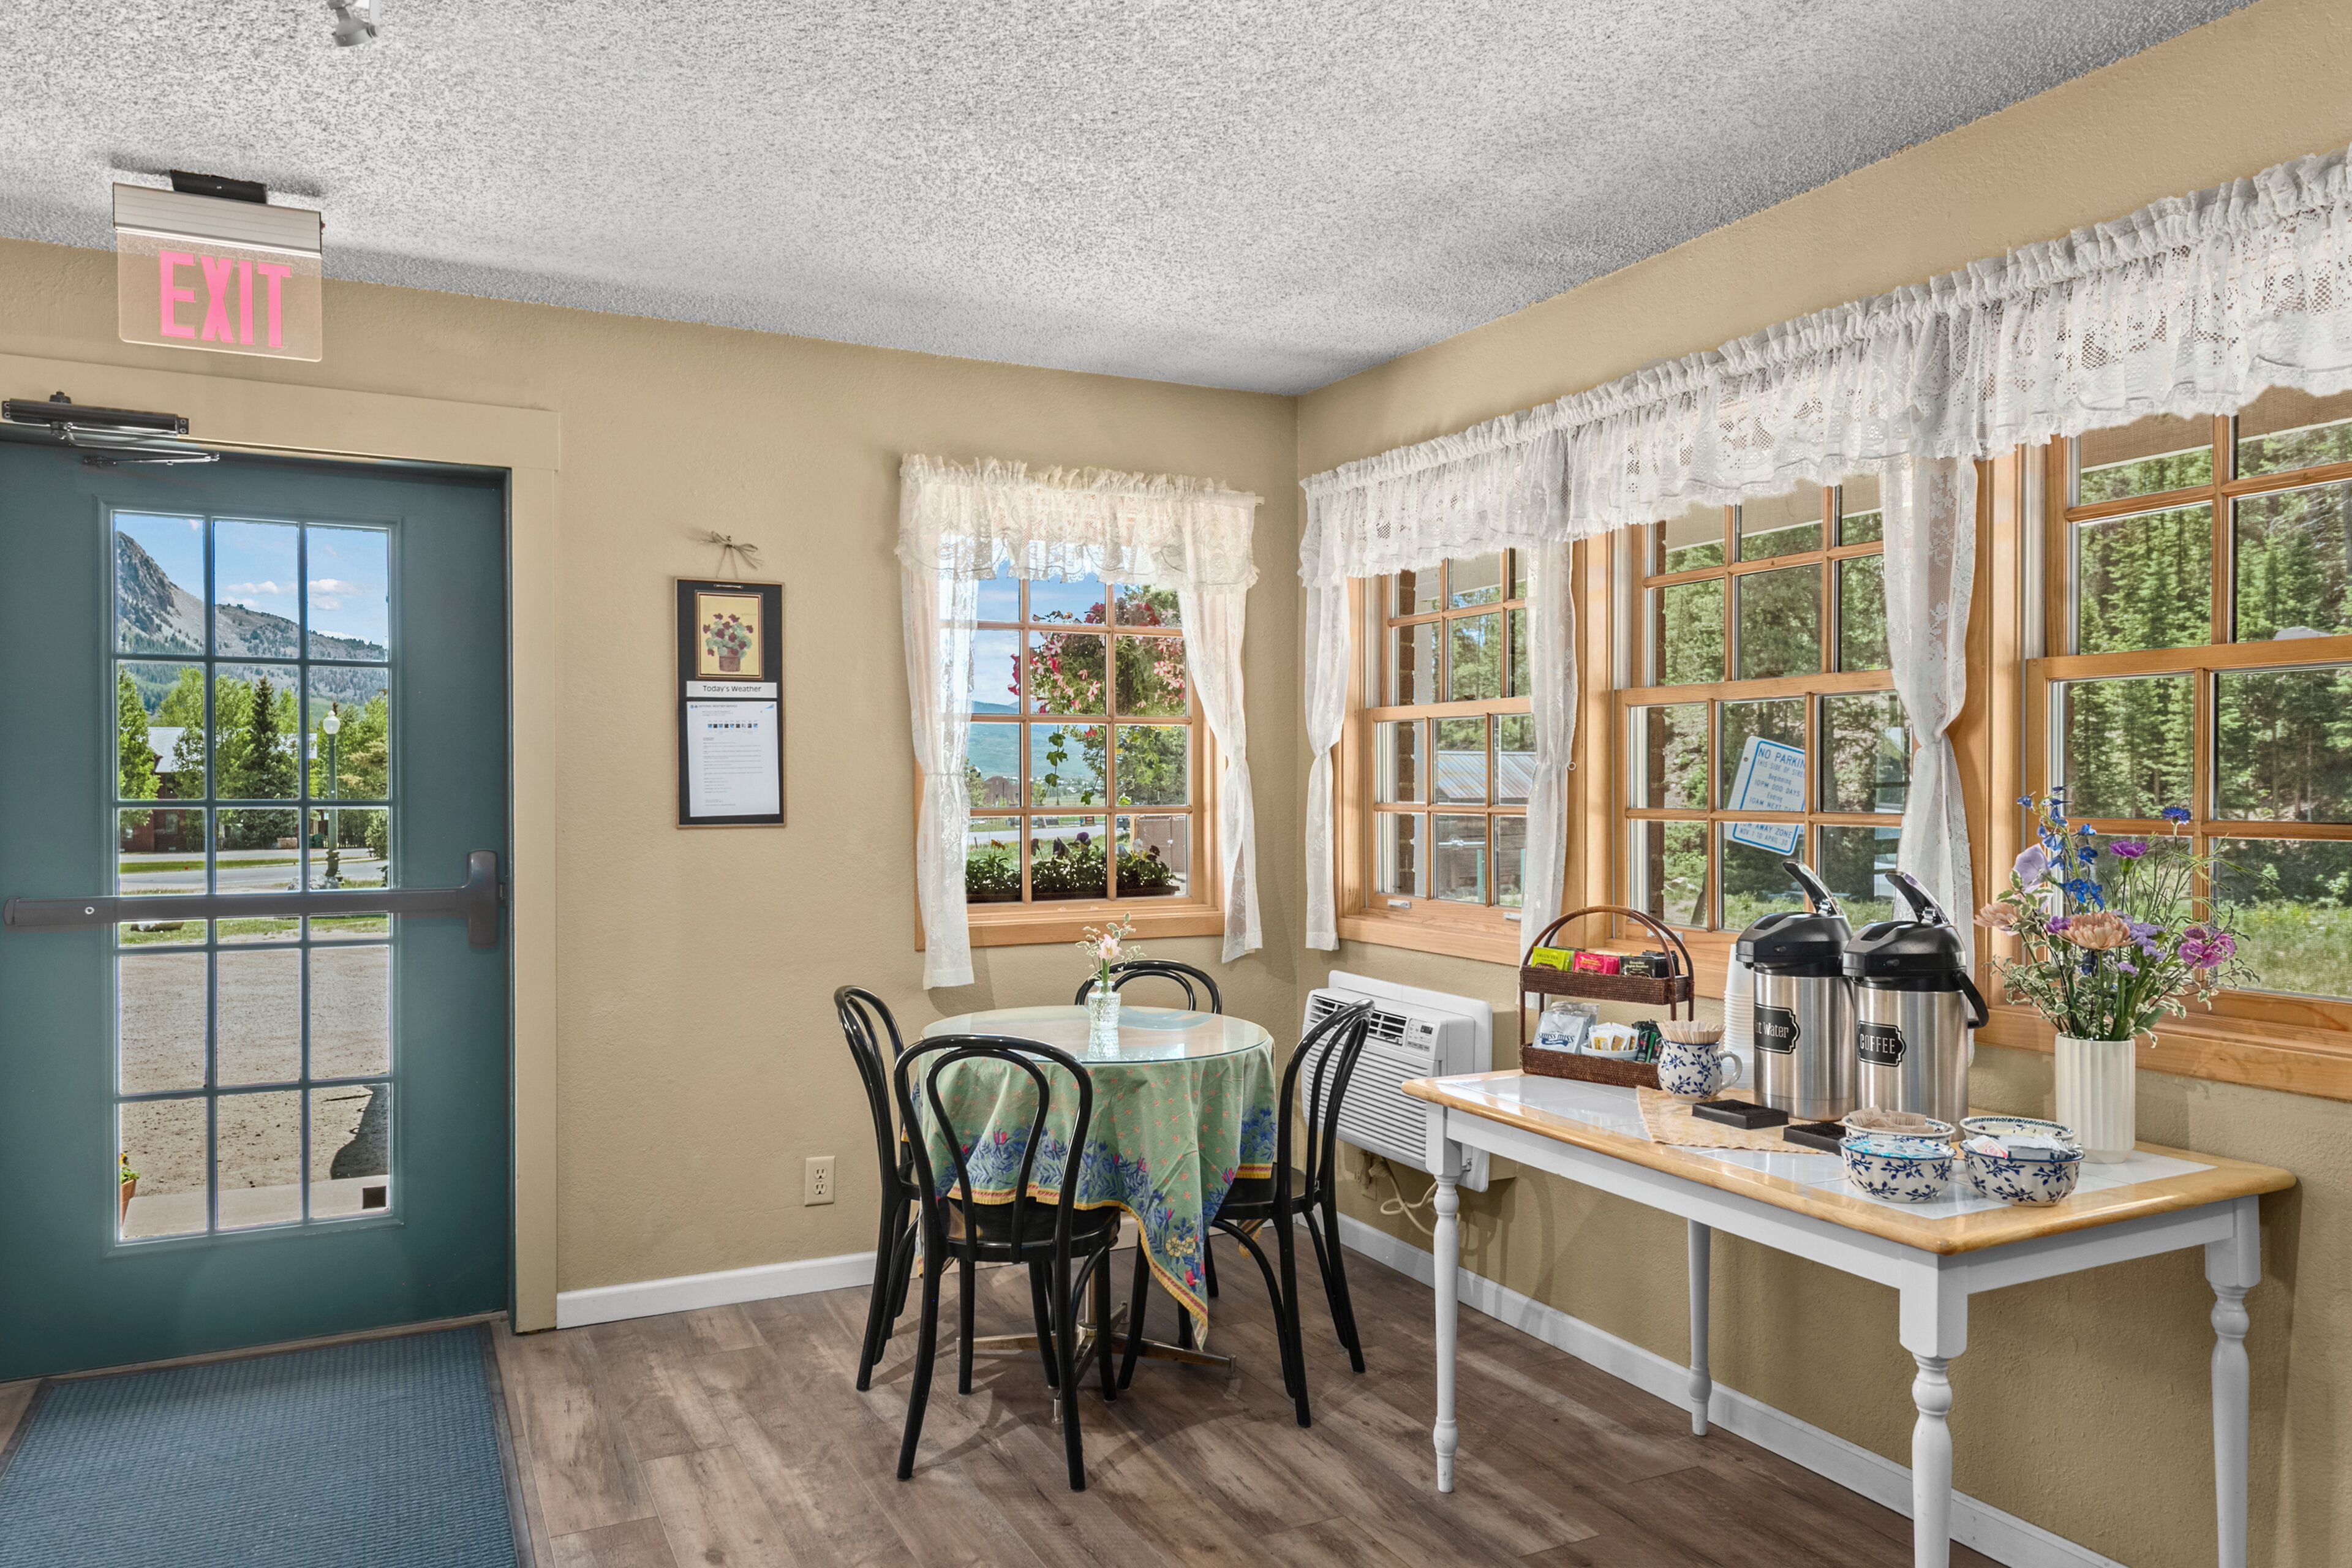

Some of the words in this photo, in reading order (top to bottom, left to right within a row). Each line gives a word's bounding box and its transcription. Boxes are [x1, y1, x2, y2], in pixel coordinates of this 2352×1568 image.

[159, 250, 292, 349] EXIT
[1758, 747, 1771, 760] NO
[1774, 752, 1805, 769] PARKIN
[1757, 759, 1768, 768] THIS
[1770, 763, 1781, 772] SIDE
[1792, 769, 1806, 778] STRE
[1768, 773, 1792, 785] Beginning
[1754, 778, 1769, 788] 10PM
[1771, 784, 1784, 793] ODD
[1785, 788, 1800, 797] DAYS
[1749, 797, 1764, 805] 10AM
[1767, 792, 1783, 803] Ending
[1755, 824, 1773, 833] AWAY
[1775, 827, 1793, 839] ZONE
[1765, 835, 1778, 844] APRIL
[1763, 1022, 1789, 1038] Water
[1860, 1033, 1896, 1054] COFFEE
